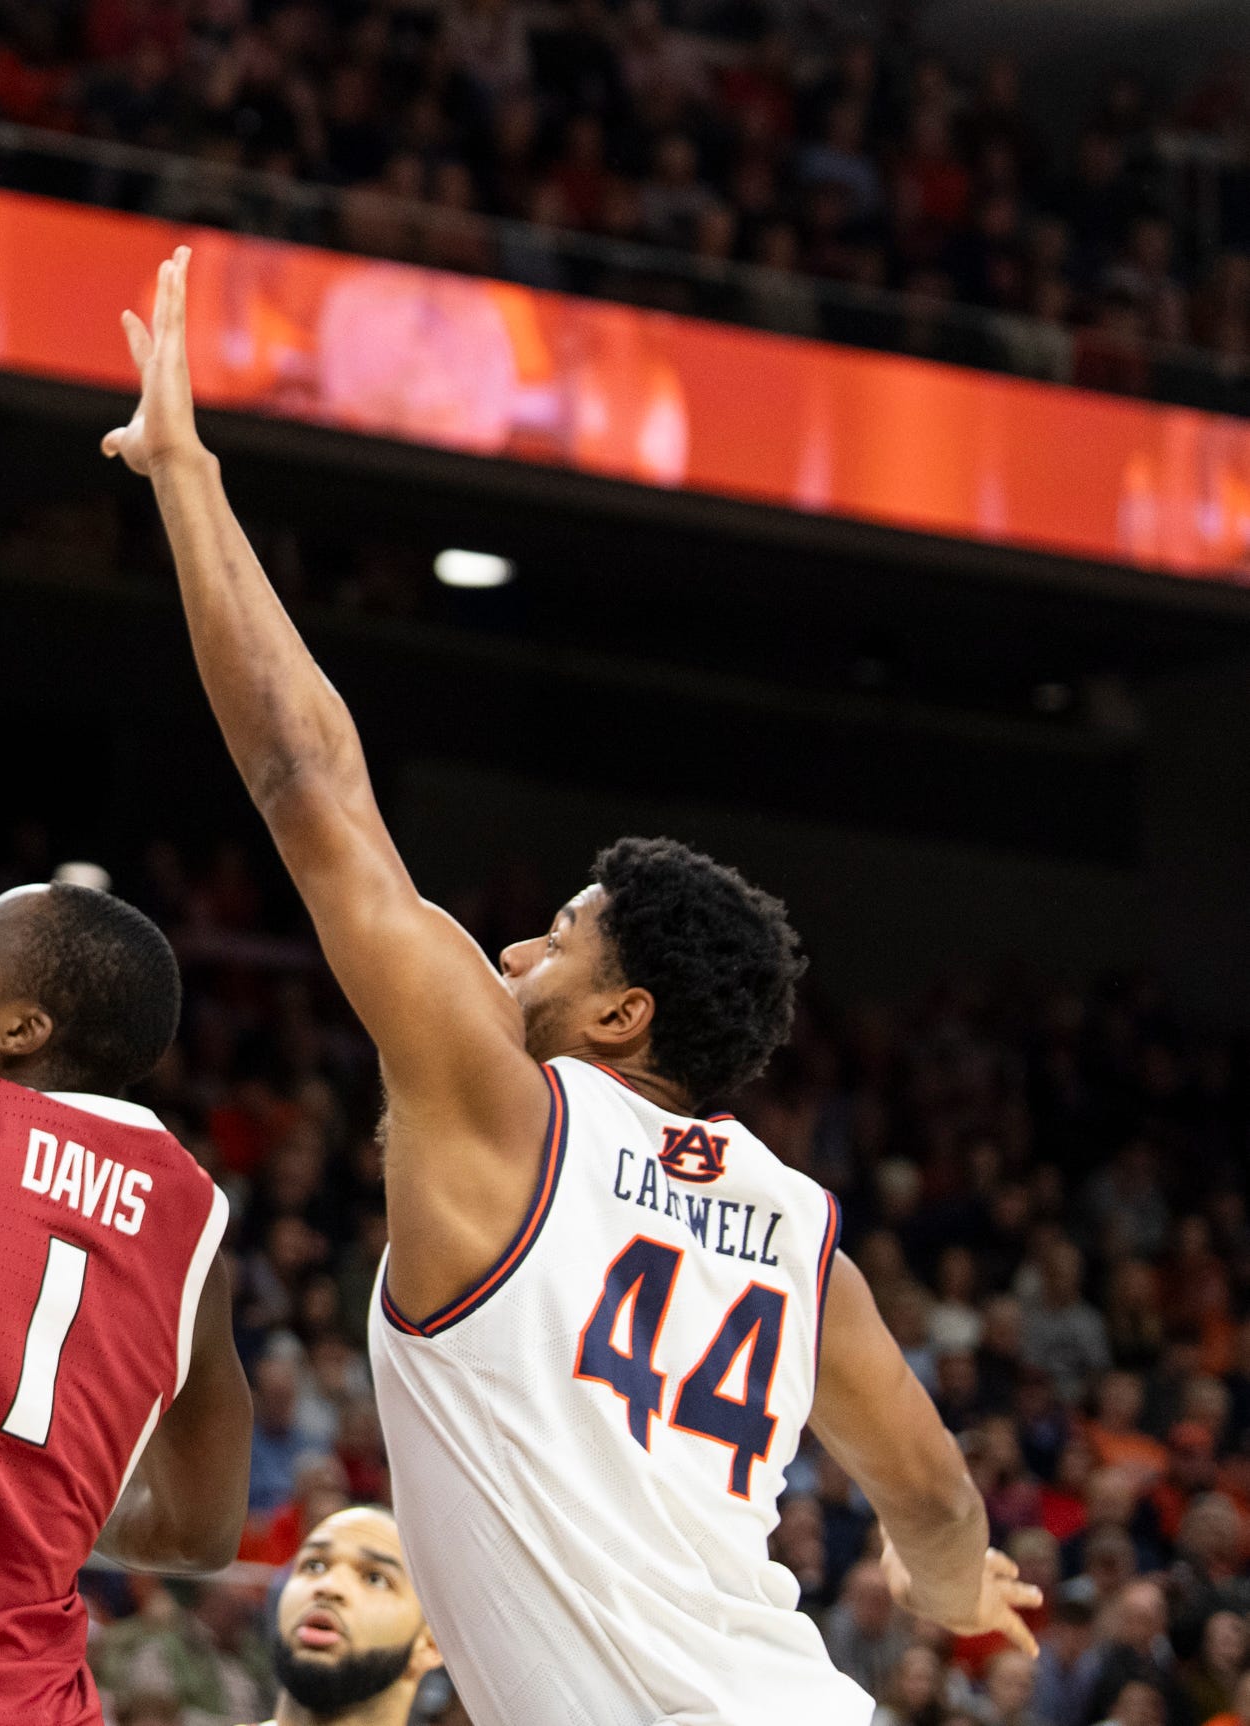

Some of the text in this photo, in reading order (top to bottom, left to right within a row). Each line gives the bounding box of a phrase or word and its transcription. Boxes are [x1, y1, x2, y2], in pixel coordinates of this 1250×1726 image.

[21, 1128, 153, 1236] DAVIS
[614, 1147, 783, 1267] CAWELL
[0, 1234, 88, 1449] 1
[573, 1233, 788, 1502] 44
